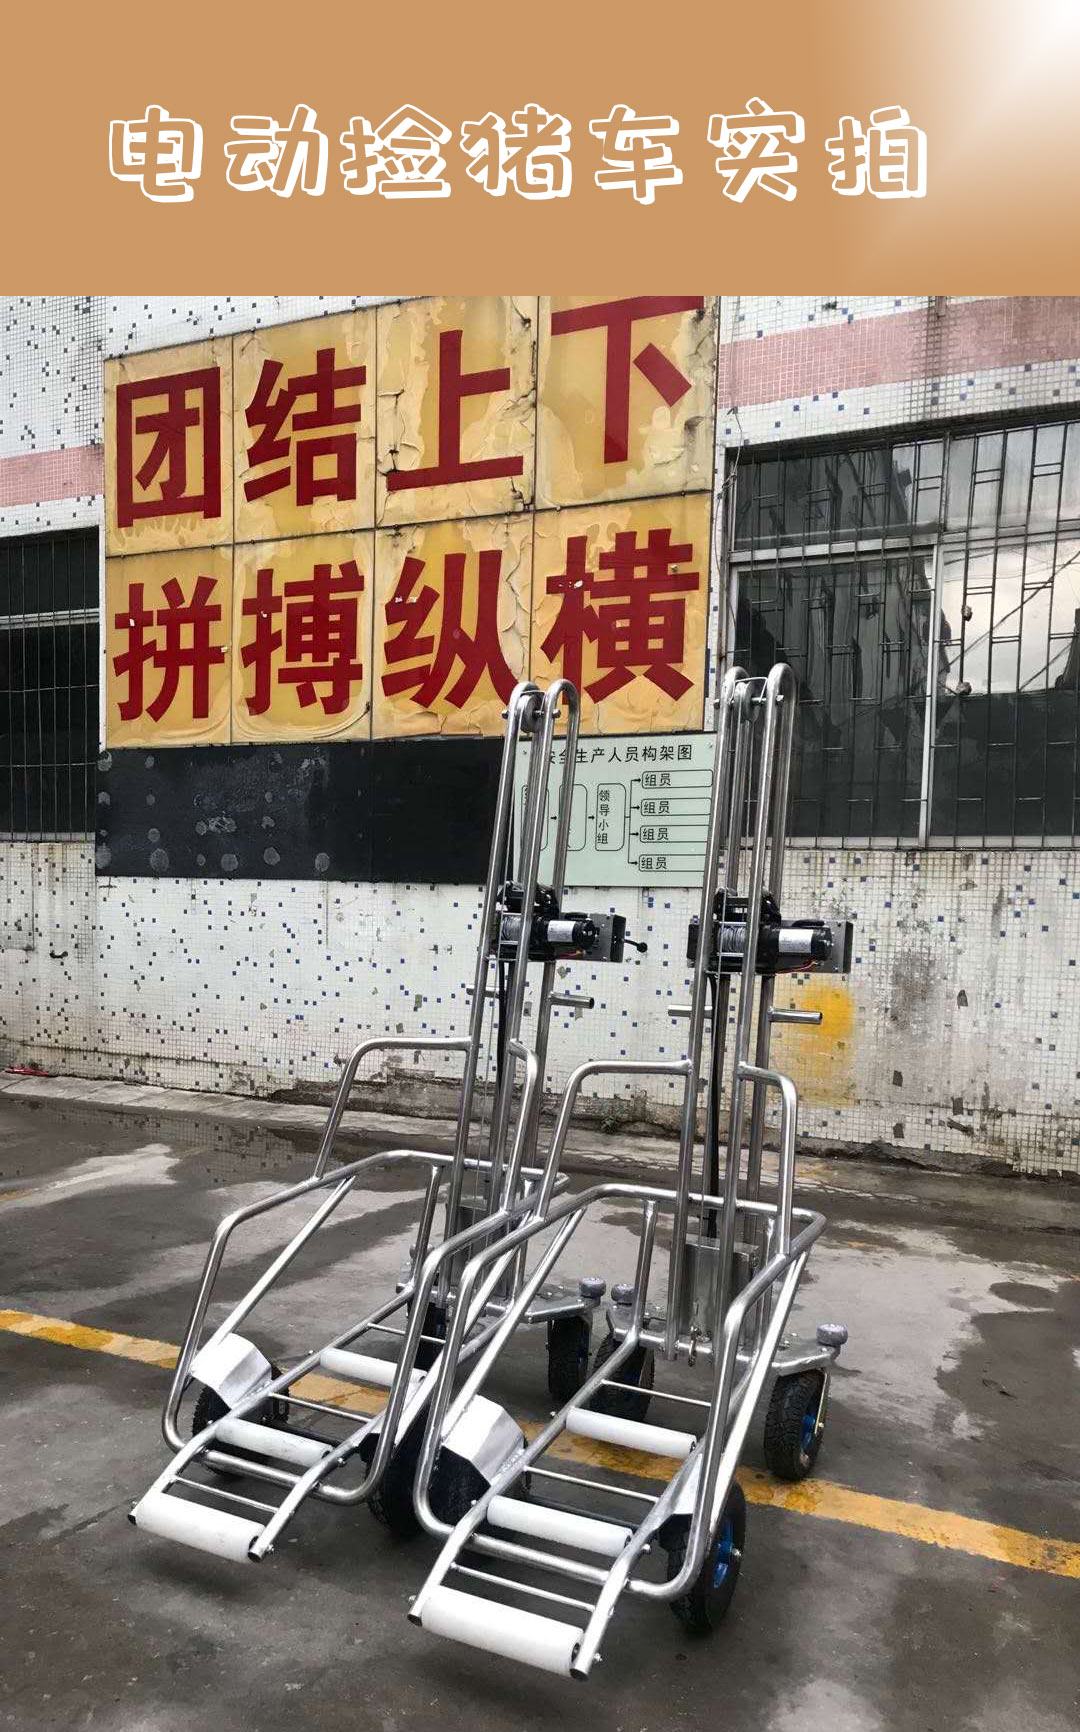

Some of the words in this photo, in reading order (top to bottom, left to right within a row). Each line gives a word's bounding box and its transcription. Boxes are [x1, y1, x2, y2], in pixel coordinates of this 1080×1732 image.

[115, 296, 704, 529] 团结上下
[112, 529, 701, 722] 拼搏纵横
[644, 773, 672, 787] 组员
[643, 800, 670, 814] 组员
[597, 789, 610, 845] 领导小组
[642, 827, 669, 841] 组员
[640, 856, 668, 870] 组员
